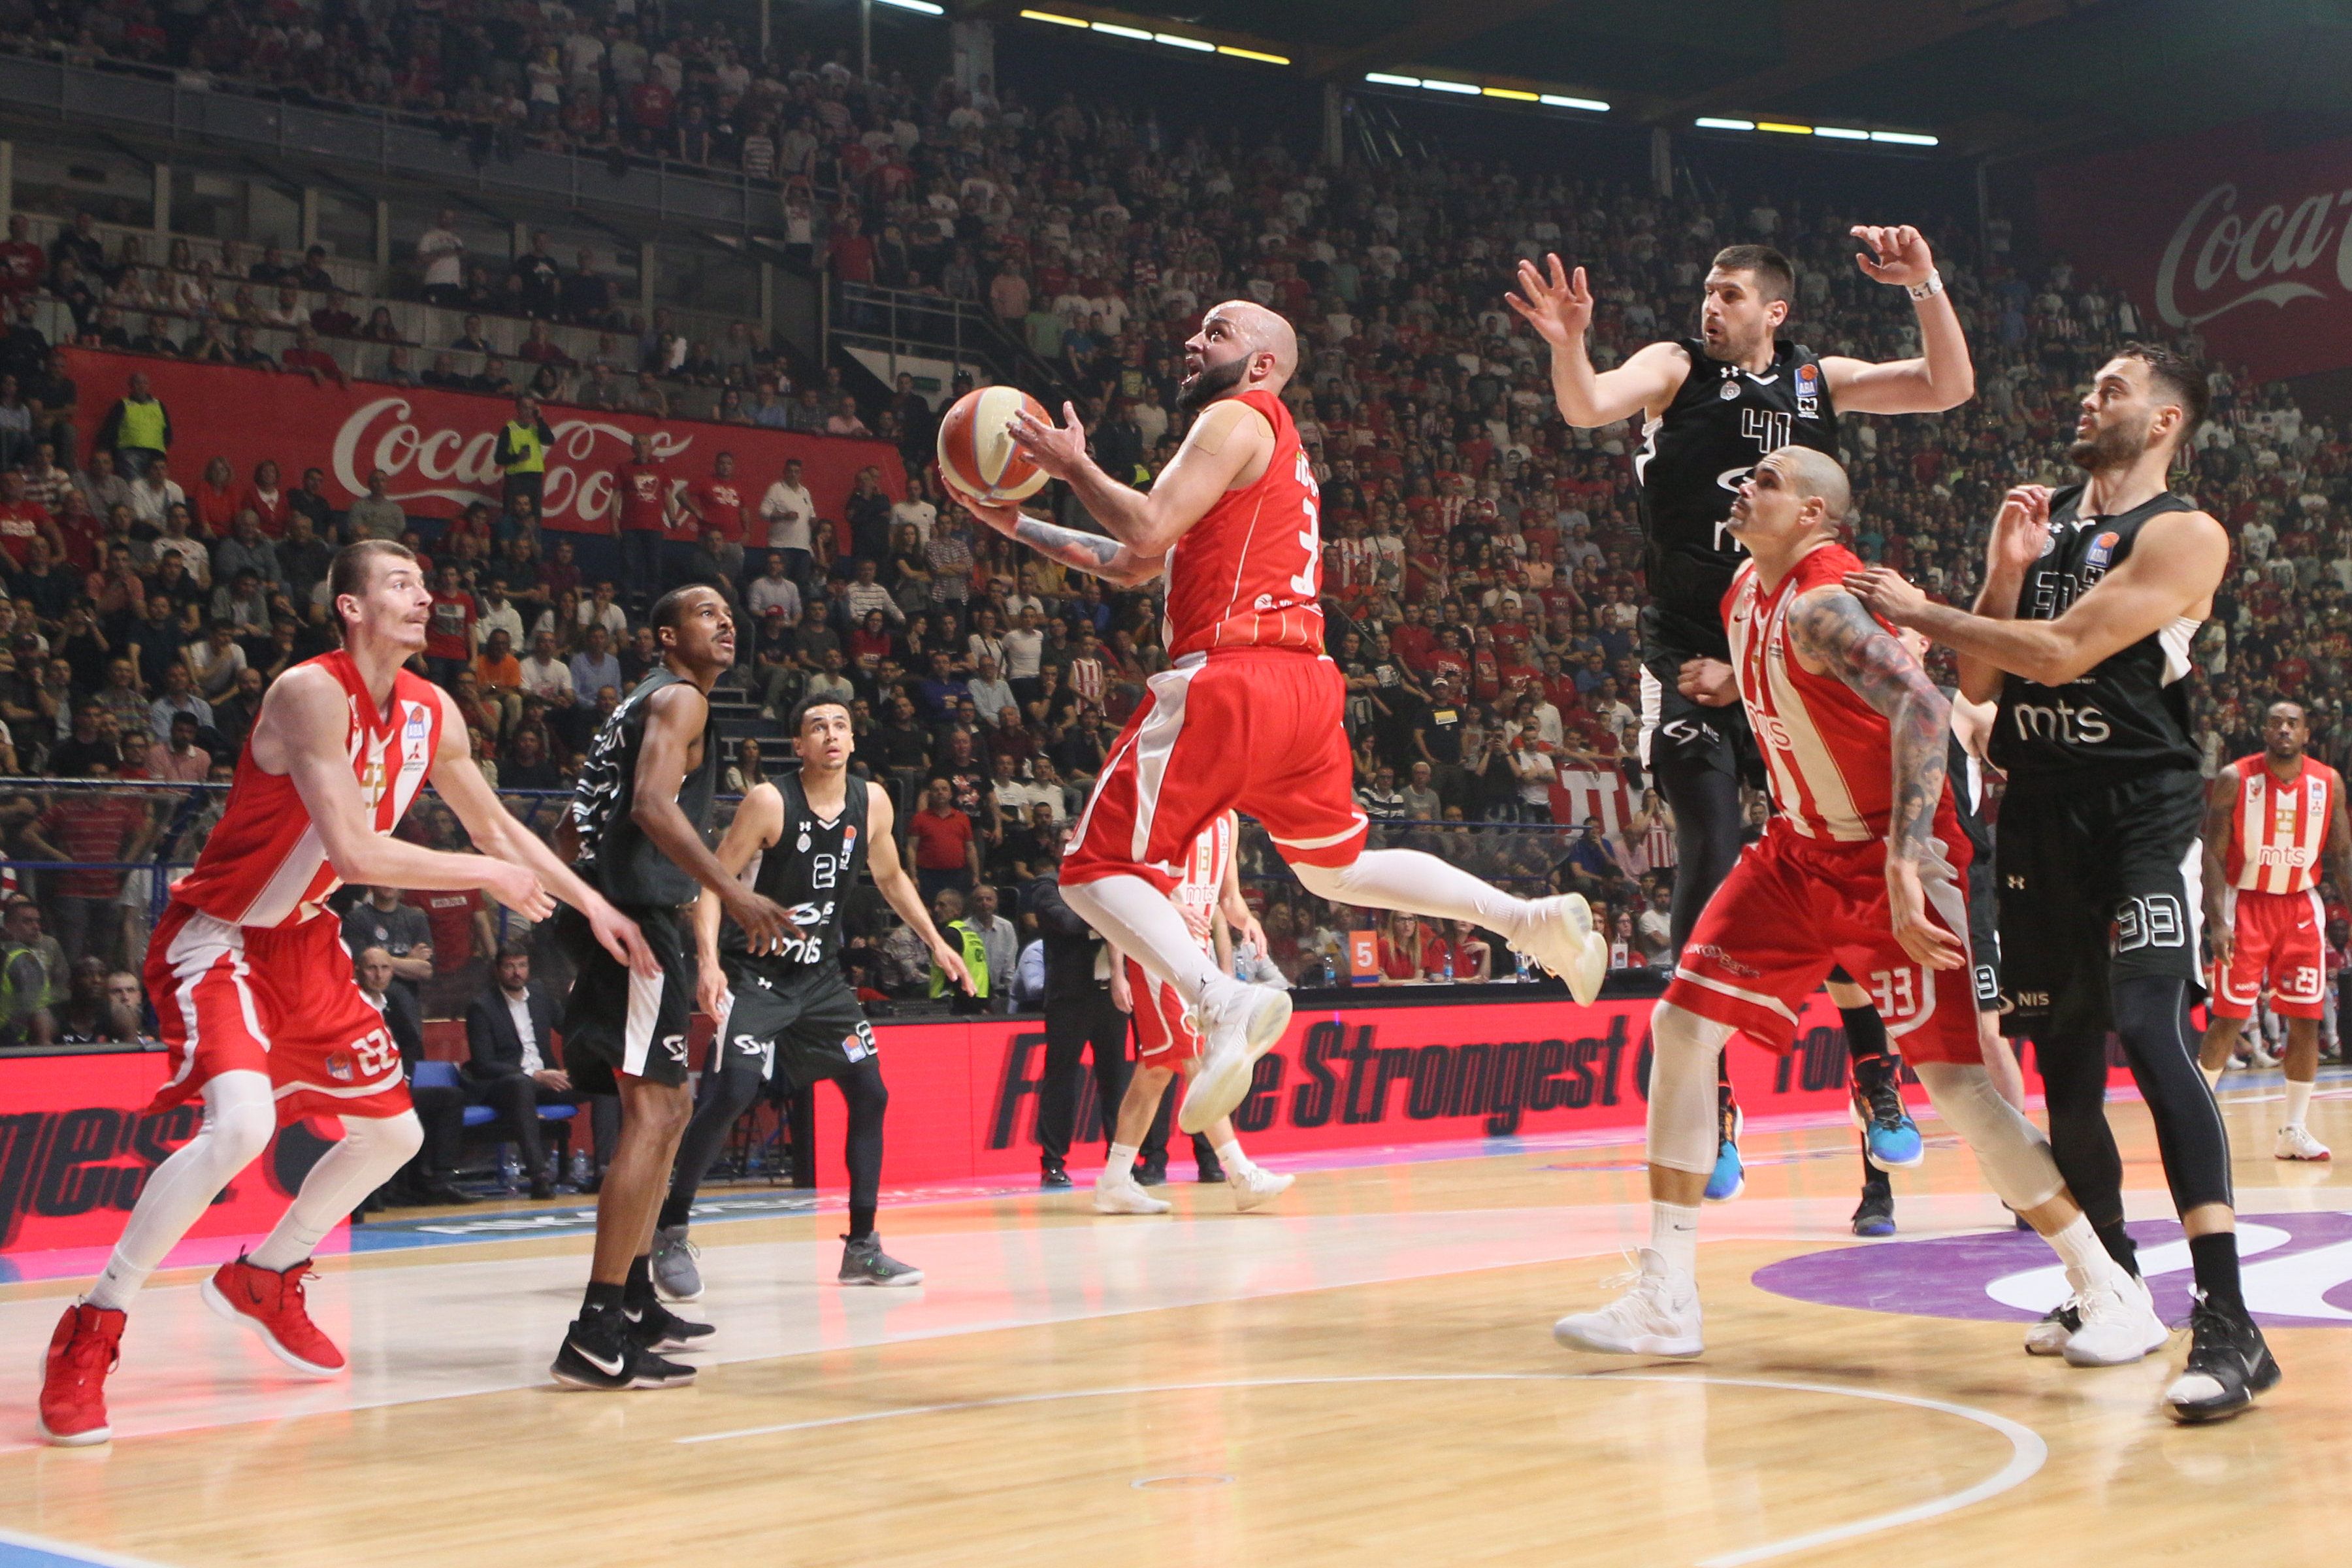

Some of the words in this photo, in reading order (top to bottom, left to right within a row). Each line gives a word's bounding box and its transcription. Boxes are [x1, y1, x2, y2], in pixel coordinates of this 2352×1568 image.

[1740, 407, 1793, 455] 41
[2014, 698, 2111, 744] mts
[813, 854, 837, 889] 2
[1198, 846, 1210, 872] 13
[2259, 845, 2306, 867] mts
[1186, 883, 1216, 904] mts
[1356, 941, 1373, 968] 5
[1871, 967, 1916, 1018] 33
[2296, 966, 2319, 994] 23
[2017, 992, 2050, 1007] NIS
[350, 1027, 397, 1077] 22
[1289, 1015, 1629, 1135] Strongest
